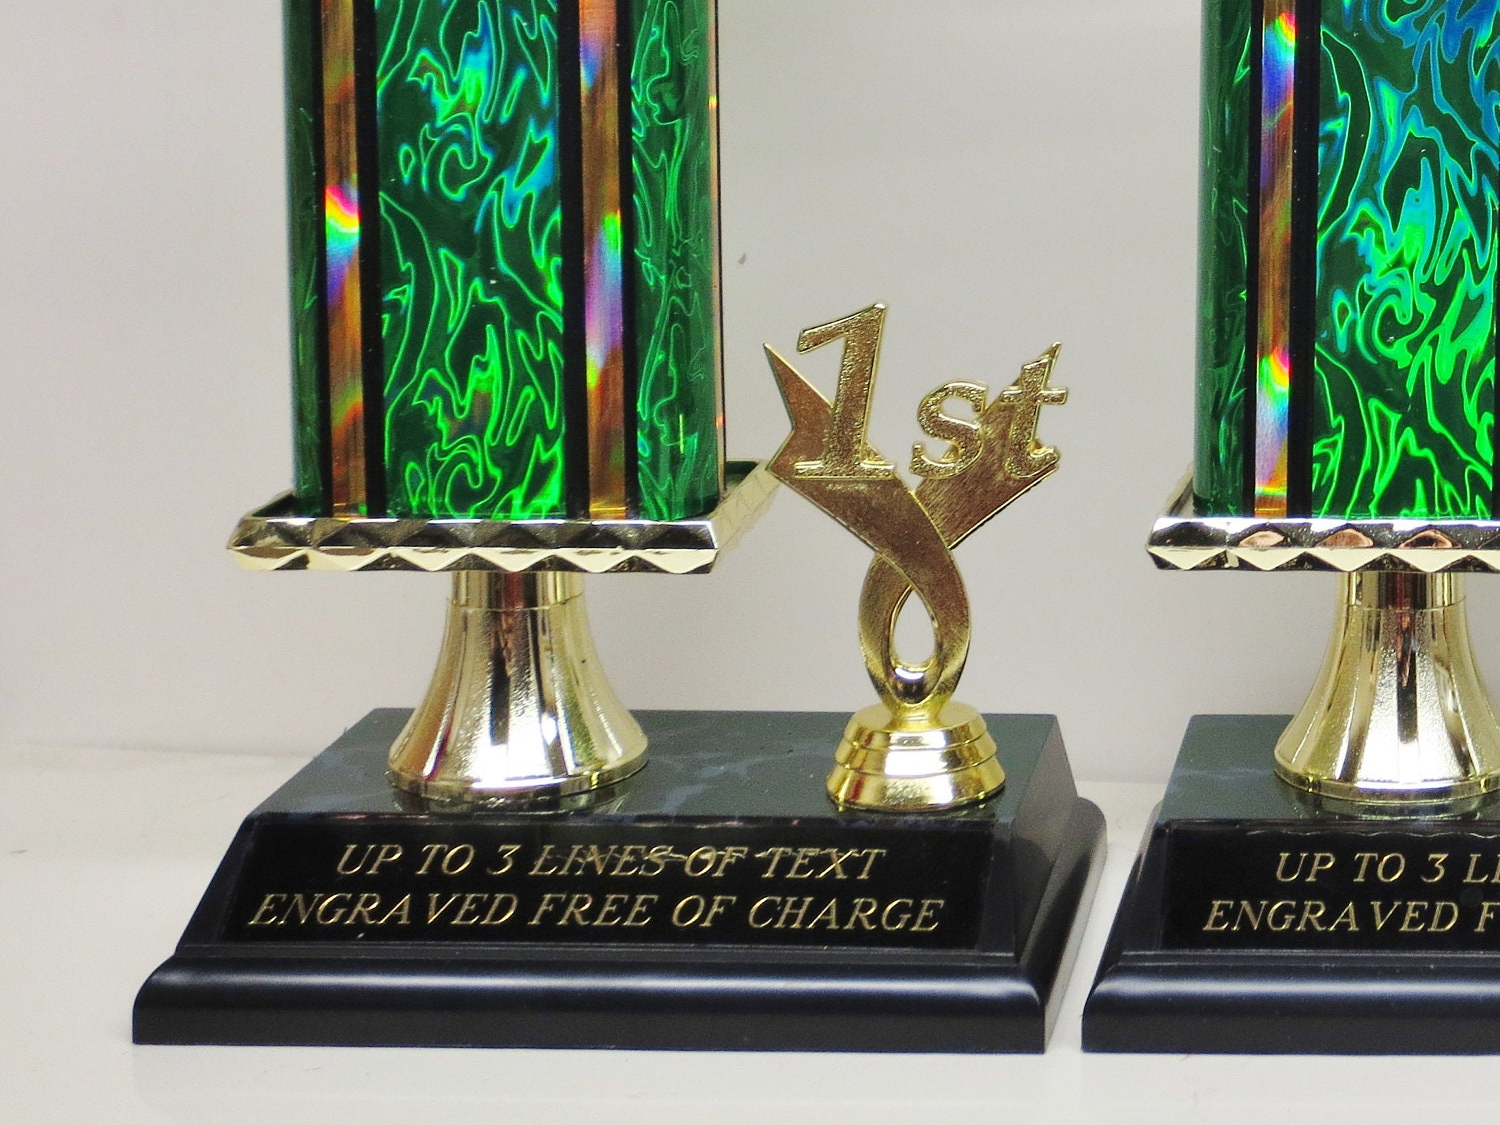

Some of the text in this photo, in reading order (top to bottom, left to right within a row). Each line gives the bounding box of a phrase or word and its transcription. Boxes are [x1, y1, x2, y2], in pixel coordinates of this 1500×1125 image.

[794, 301, 1068, 479] 1st
[336, 844, 887, 880] UP TO 3 LINES OF TEXT
[1275, 852, 1336, 883] UP
[1354, 853, 1406, 883] TO
[1420, 853, 1446, 883] 3
[249, 893, 945, 932] ENGRAVED FREE OF CHARGE
[1202, 900, 1460, 933] ENGRAVED
